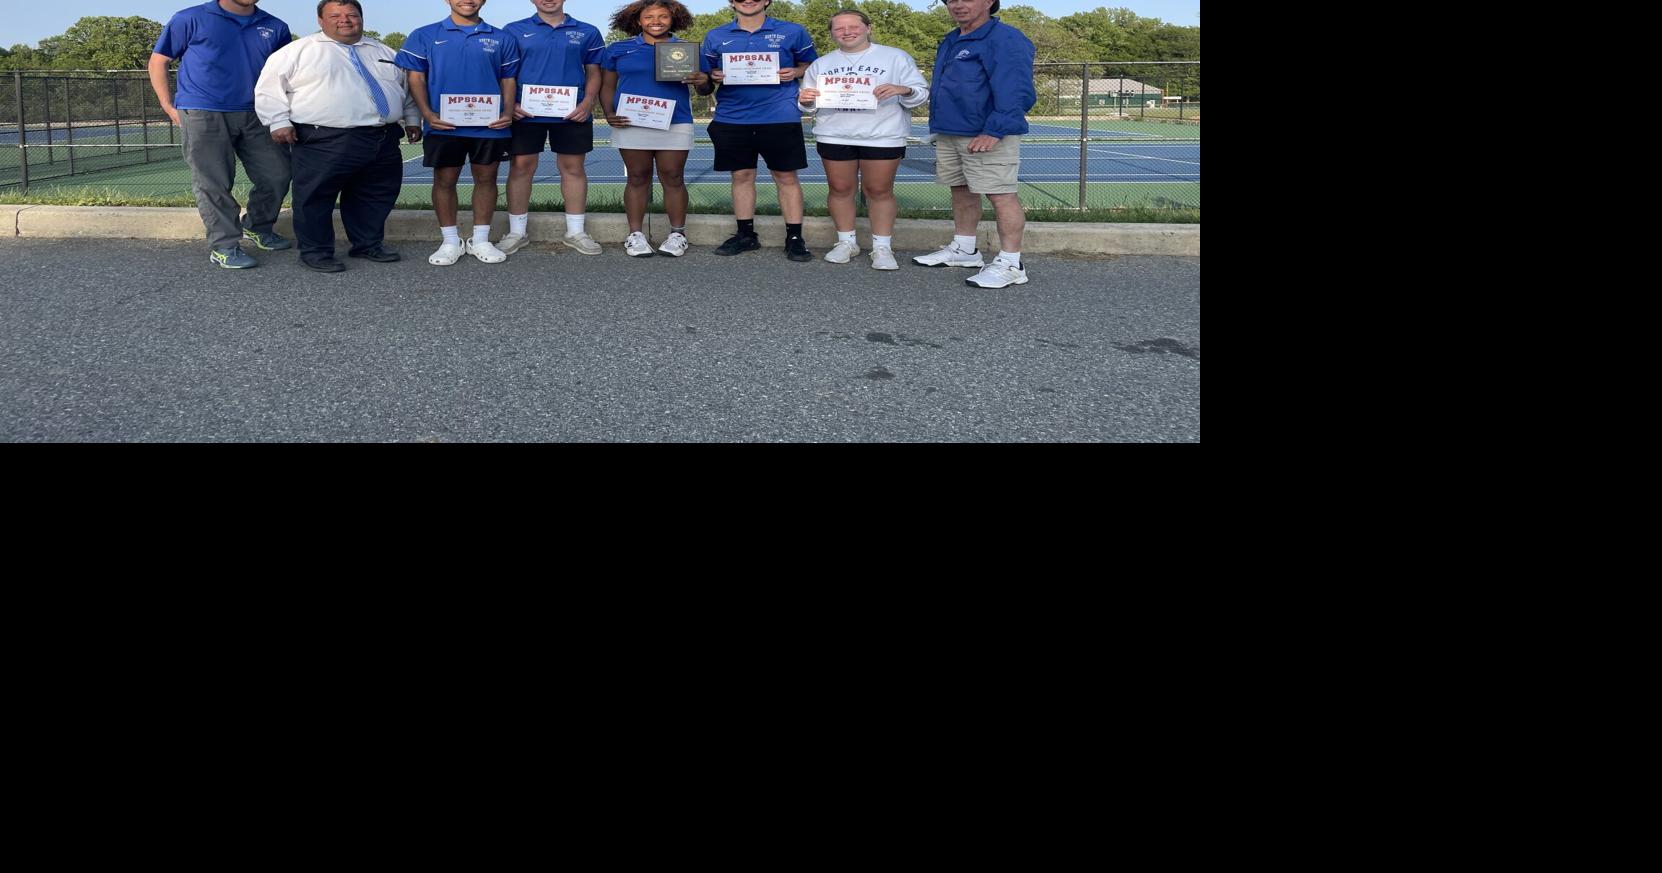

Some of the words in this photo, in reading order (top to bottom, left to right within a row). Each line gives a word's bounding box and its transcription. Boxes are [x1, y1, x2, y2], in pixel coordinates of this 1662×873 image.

[729, 54, 772, 63] MPSSAA
[858, 64, 886, 75] EAST
[824, 77, 871, 86] MPSSAA
[529, 87, 570, 96] MPSSAA
[448, 96, 492, 104] MPSSAA
[626, 96, 668, 109] MPSSAA
